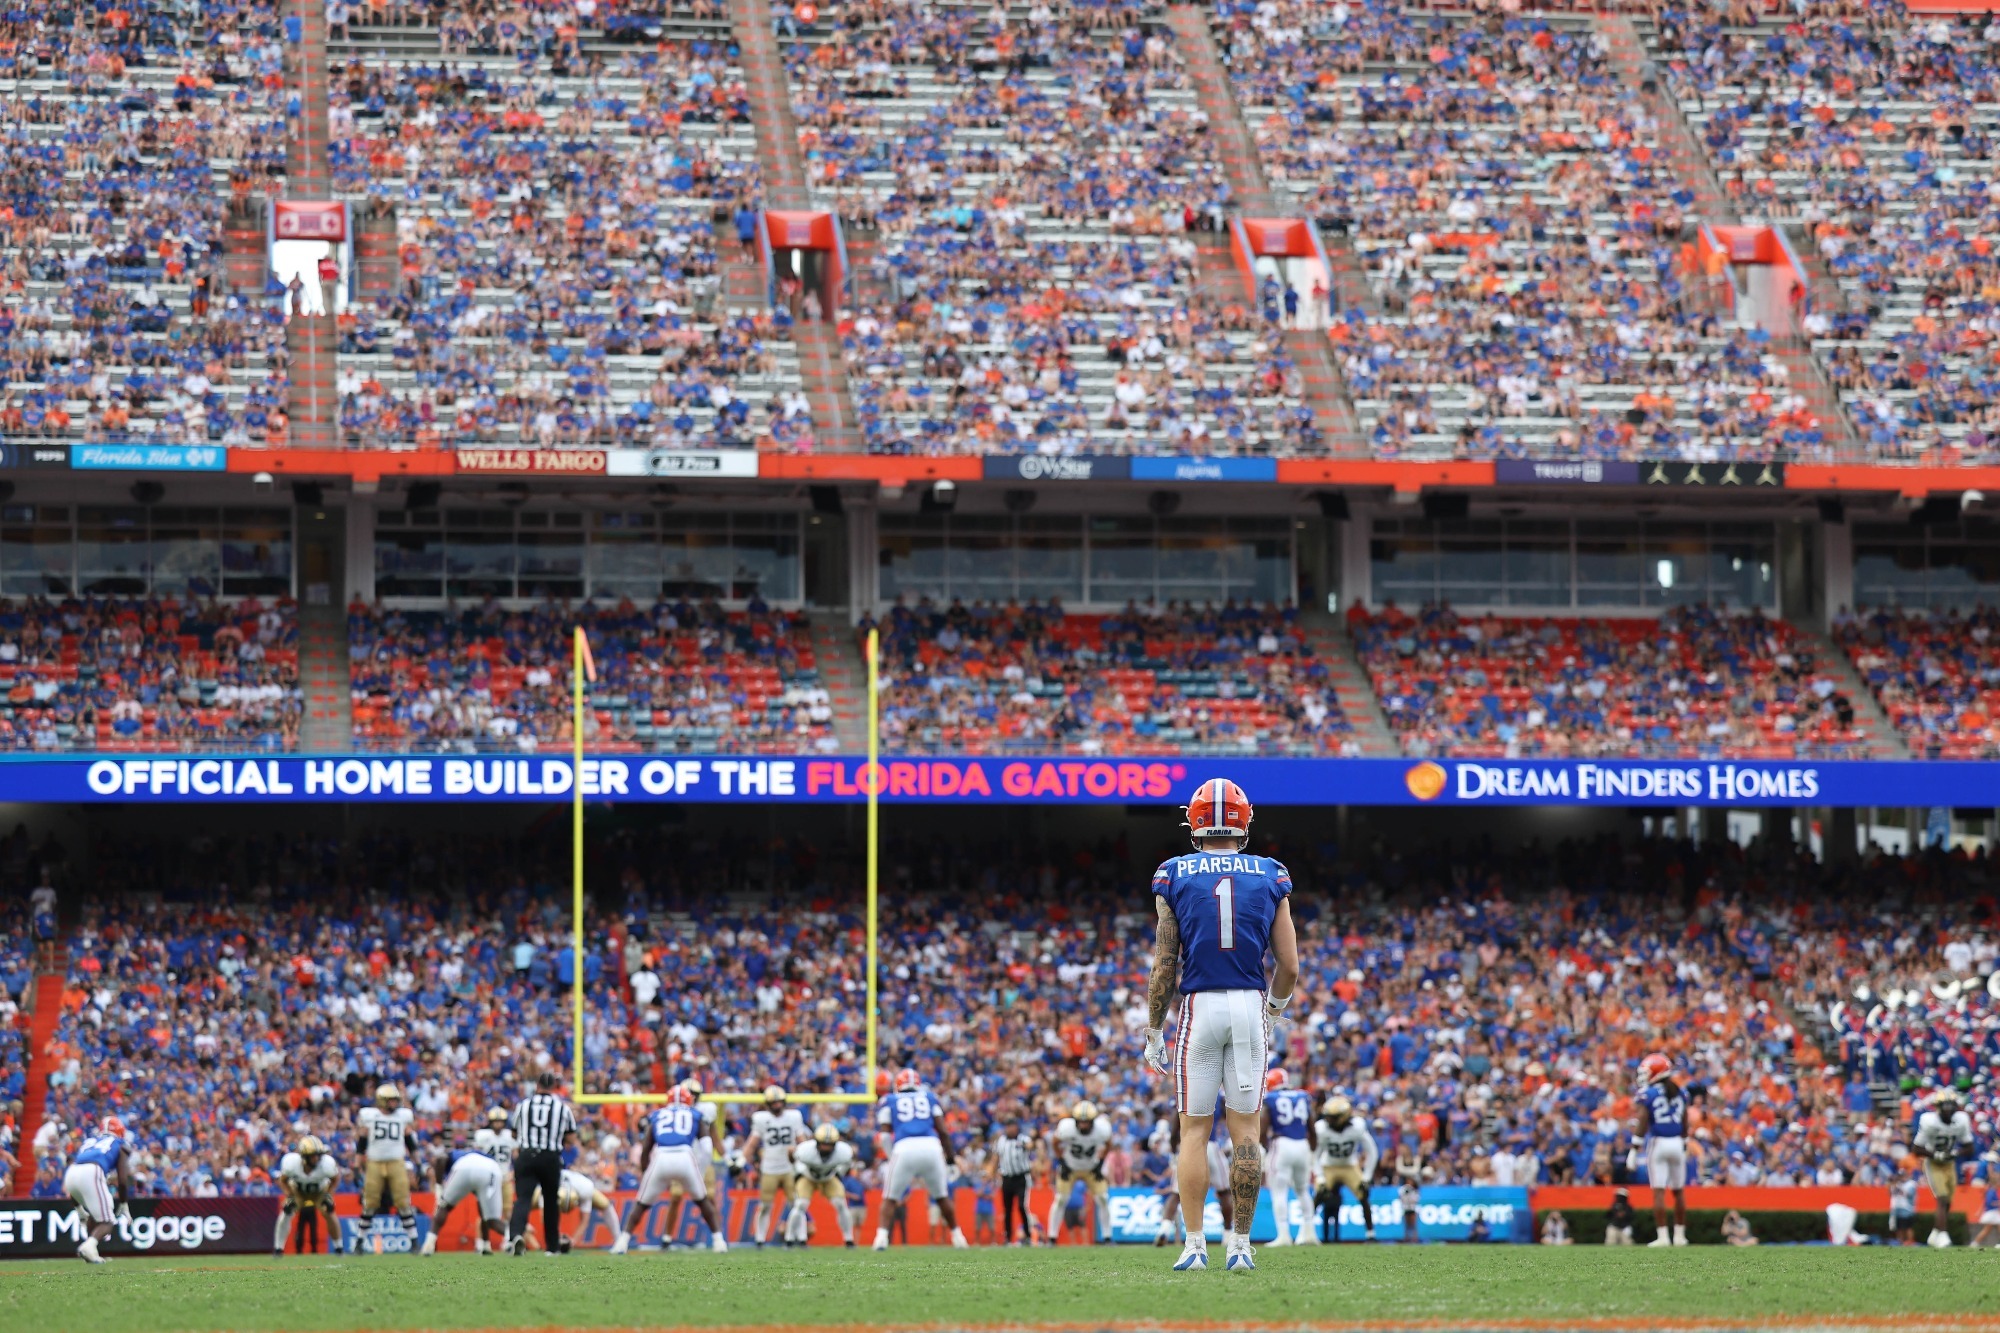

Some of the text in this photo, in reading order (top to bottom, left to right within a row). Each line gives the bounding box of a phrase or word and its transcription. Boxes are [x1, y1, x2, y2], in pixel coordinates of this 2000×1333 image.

[81, 450, 181, 466] Florida Blue
[457, 451, 605, 471] WELLS FARGO
[87, 760, 1172, 797] OFFICIAL HOME BUILDER OF THE FLORIDA GATORS
[1456, 764, 1819, 799] DREAM FINDERS HOMES
[1177, 857, 1266, 877] PEARSALL
[1213, 876, 1236, 950] 1
[532, 1104, 551, 1127] U
[896, 1096, 931, 1122] 99
[1275, 1096, 1308, 1126] 94
[374, 1120, 400, 1141] 50
[655, 1109, 693, 1136] 20
[767, 1126, 792, 1146] 32
[0, 1209, 226, 1249] ET Mtgage
